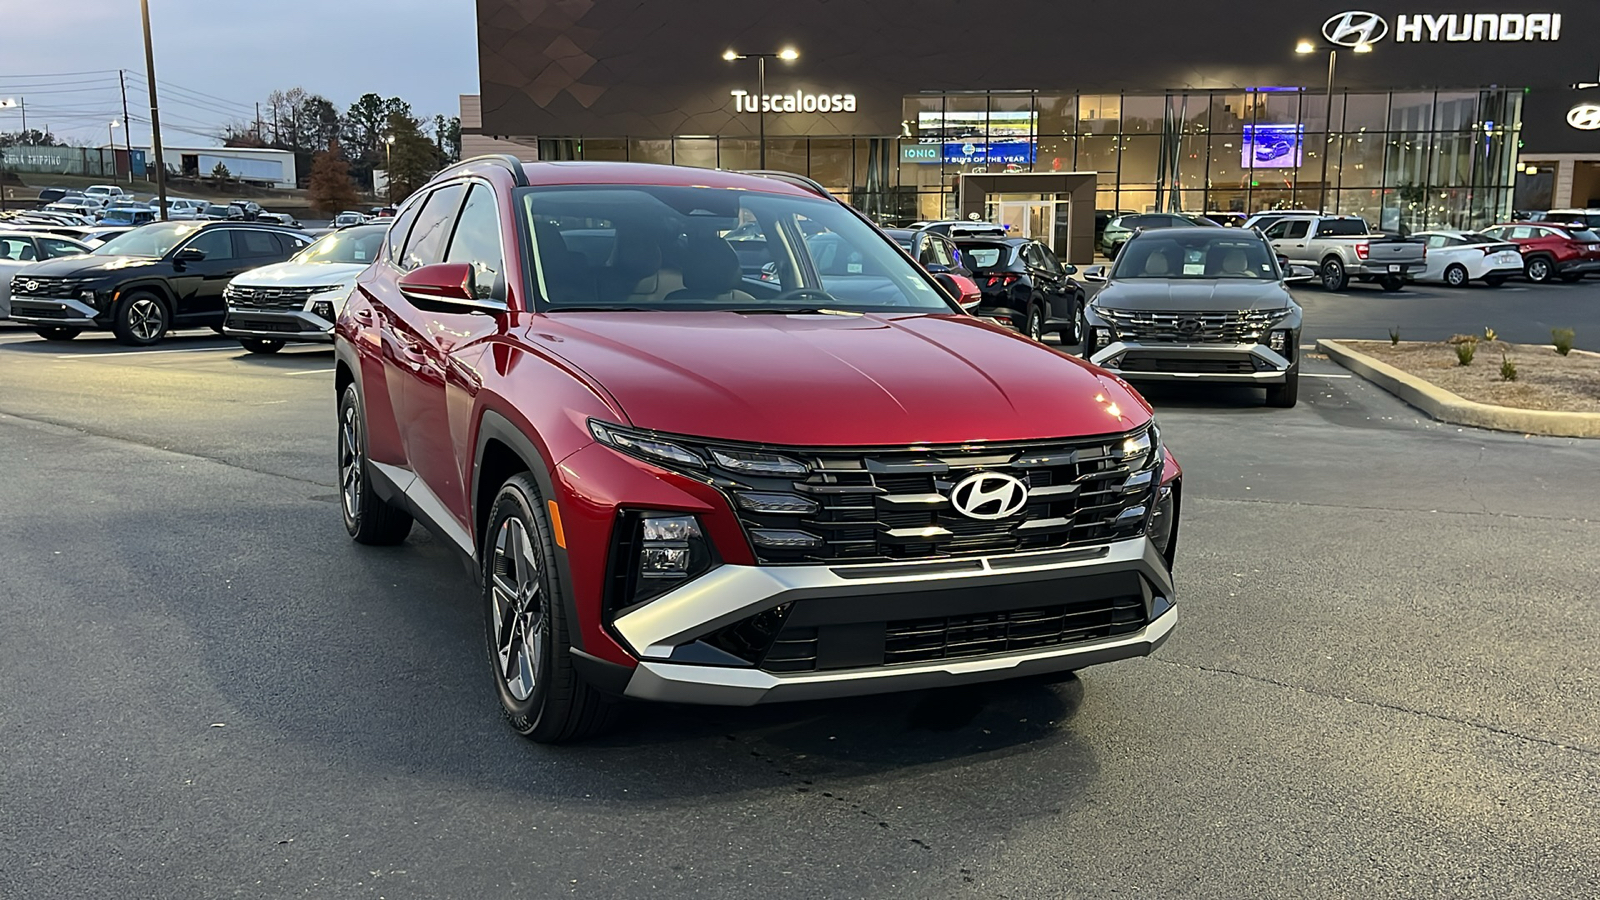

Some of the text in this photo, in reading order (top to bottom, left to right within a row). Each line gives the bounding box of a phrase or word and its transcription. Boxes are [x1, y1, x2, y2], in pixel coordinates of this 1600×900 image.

[1396, 13, 1562, 42] HYUNDAI
[730, 89, 857, 113] Tuscaloosa
[904, 149, 936, 158] IONIQ
